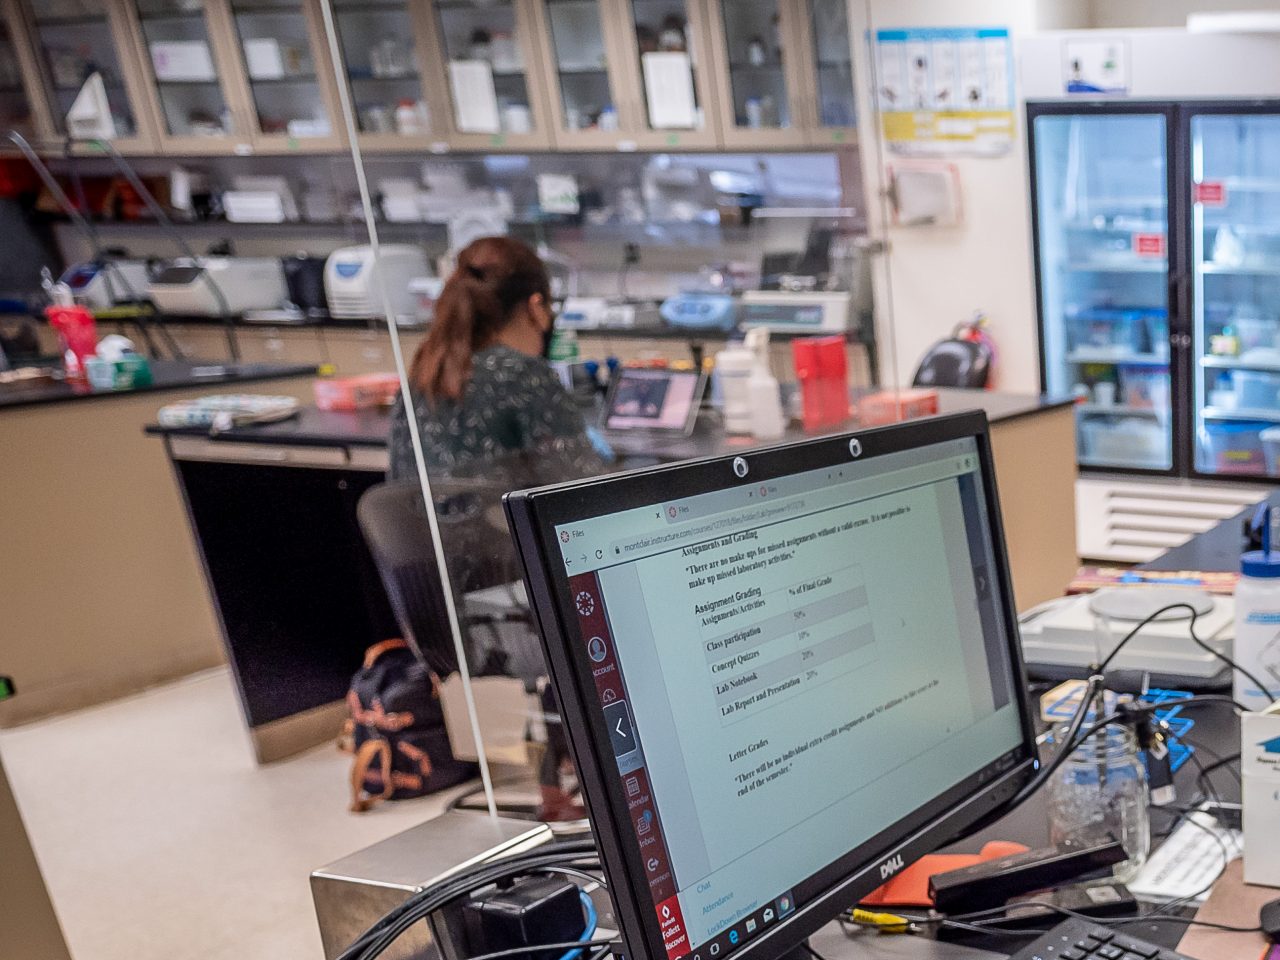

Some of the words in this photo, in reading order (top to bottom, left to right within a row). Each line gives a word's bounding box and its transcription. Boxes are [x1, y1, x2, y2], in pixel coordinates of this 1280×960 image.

[678, 505, 690, 514] Files
[572, 529, 585, 539] Files
[682, 539, 720, 558] Assignments
[721, 535, 733, 547] and
[733, 530, 758, 542] Grading
[709, 560, 720, 569] are
[720, 557, 729, 566] no
[729, 551, 746, 564] make
[757, 545, 766, 555] for
[767, 539, 786, 553] missed
[688, 576, 706, 590] make
[706, 574, 716, 585] up
[716, 566, 737, 581] missed
[736, 559, 767, 575] laboratory
[694, 593, 736, 615] Assignment
[735, 586, 762, 602] Grading
[706, 638, 724, 652] Class
[723, 626, 762, 649] participation
[711, 657, 737, 674] Concept
[737, 649, 760, 665] Quizzes
[715, 682, 730, 696] Lab
[730, 671, 759, 689] Notebook
[721, 704, 735, 717] Lab
[734, 695, 755, 710] Report
[755, 689, 767, 702] and
[766, 677, 800, 697] Presentation
[728, 747, 748, 762] Letter
[747, 737, 769, 753] Grades
[755, 761, 767, 775] will
[766, 760, 774, 769] be
[774, 757, 782, 765] no
[737, 784, 749, 797] end
[749, 779, 757, 792] of
[755, 777, 765, 788] the
[880, 854, 905, 880] DELL
[696, 880, 712, 894] Chat
[702, 891, 735, 915] Attendance
